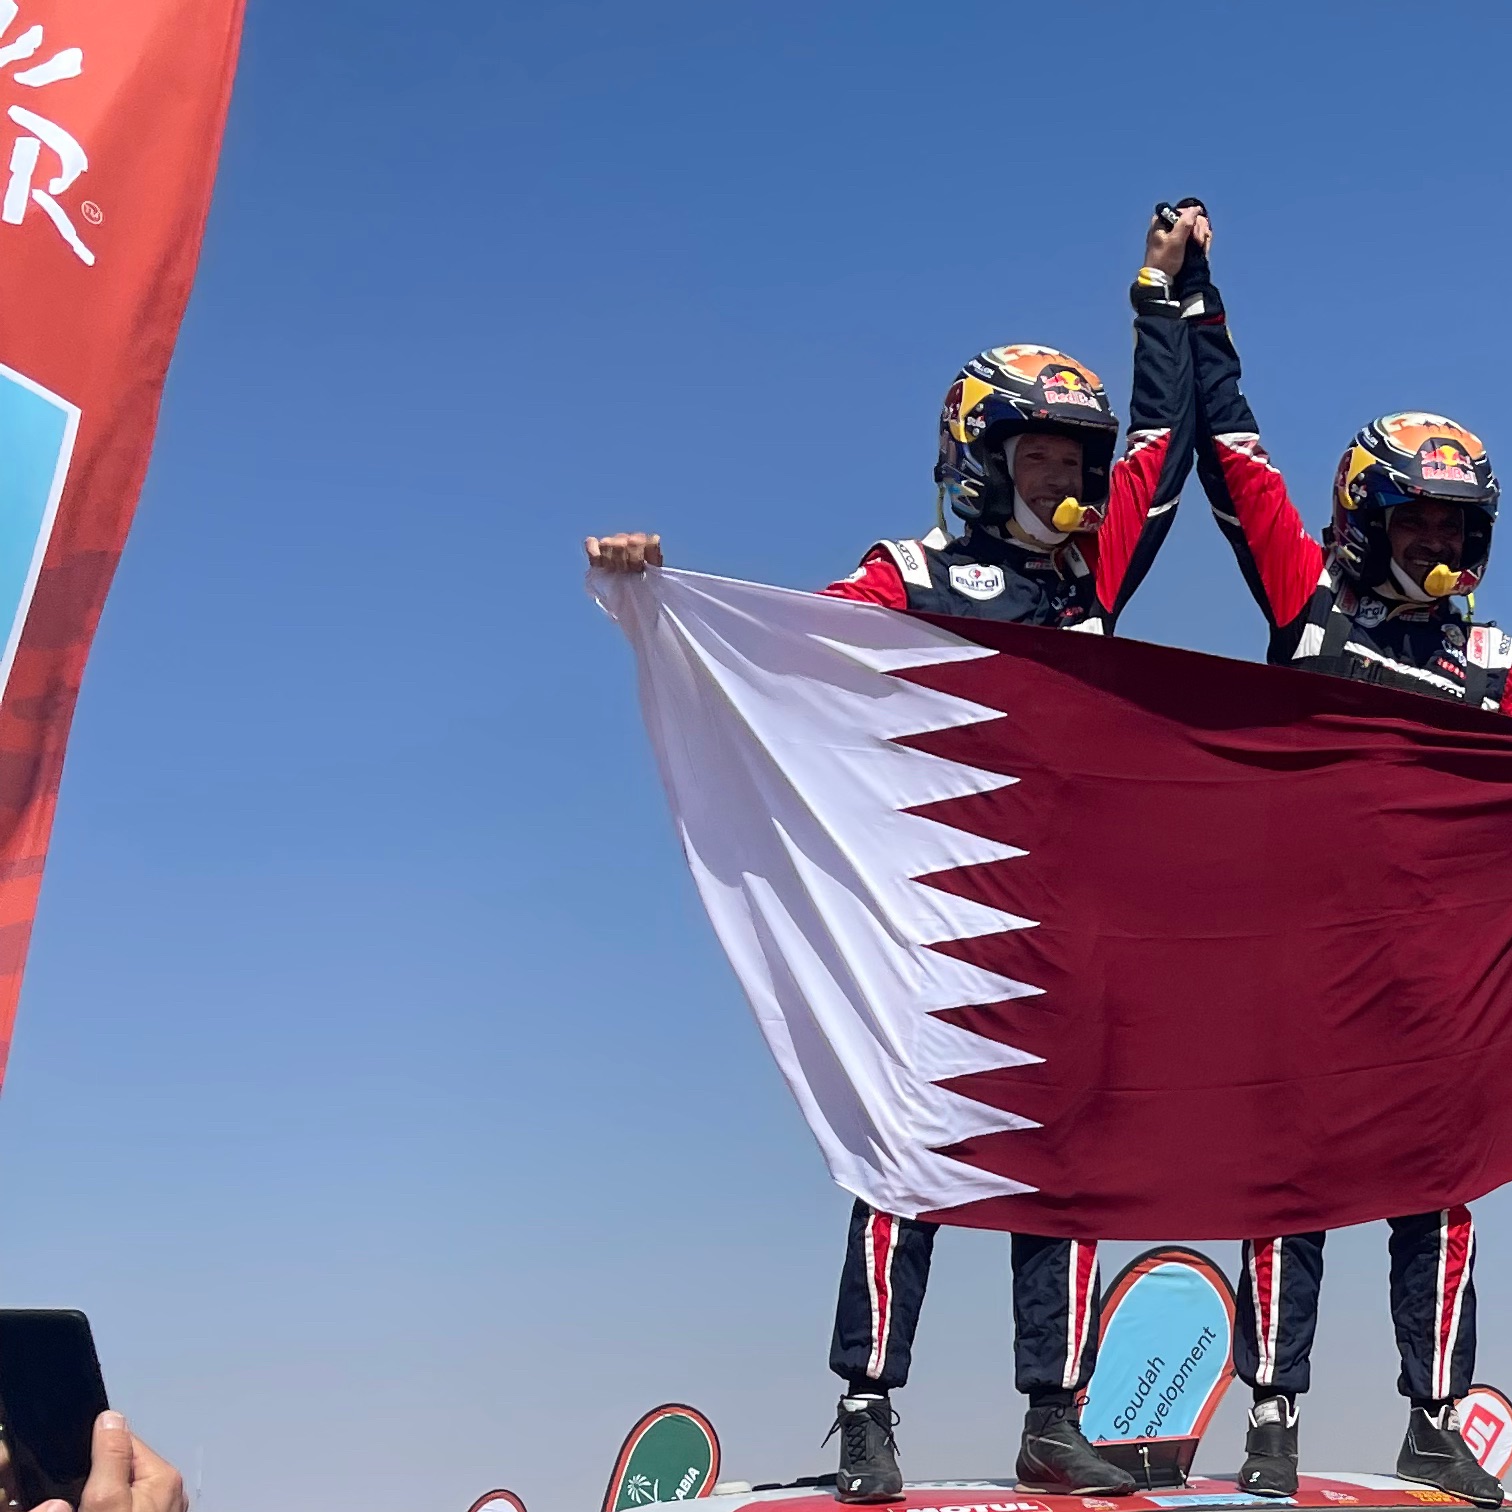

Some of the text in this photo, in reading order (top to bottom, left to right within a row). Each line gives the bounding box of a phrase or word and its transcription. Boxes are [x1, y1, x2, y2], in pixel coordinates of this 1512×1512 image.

[955, 575, 999, 590] eurol
[1113, 1356, 1165, 1435] Soudah
[1136, 1326, 1216, 1439] evelopment
[671, 1467, 700, 1500] ABIA
